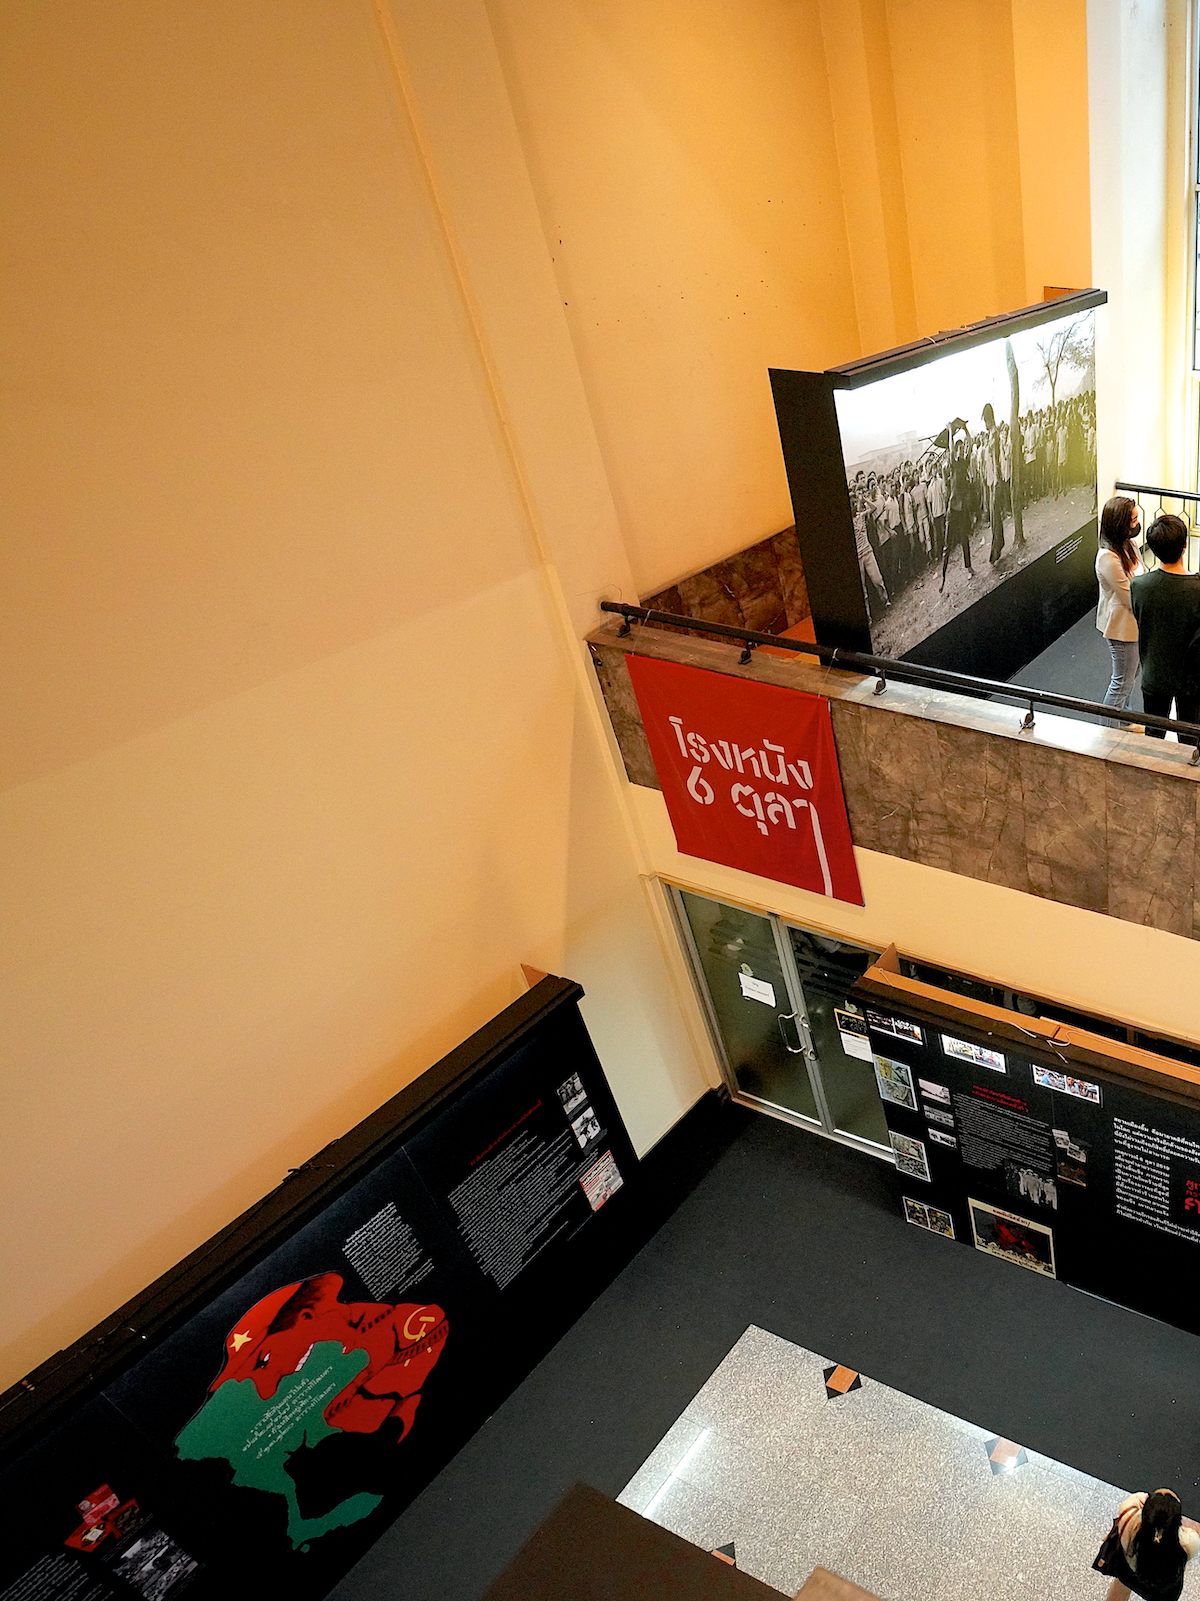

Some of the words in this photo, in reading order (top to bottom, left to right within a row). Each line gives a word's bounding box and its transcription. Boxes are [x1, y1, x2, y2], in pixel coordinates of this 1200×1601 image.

[668, 715, 814, 790] โรงหนัง
[686, 765, 715, 805] 6
[731, 782, 834, 898] ตุลา
